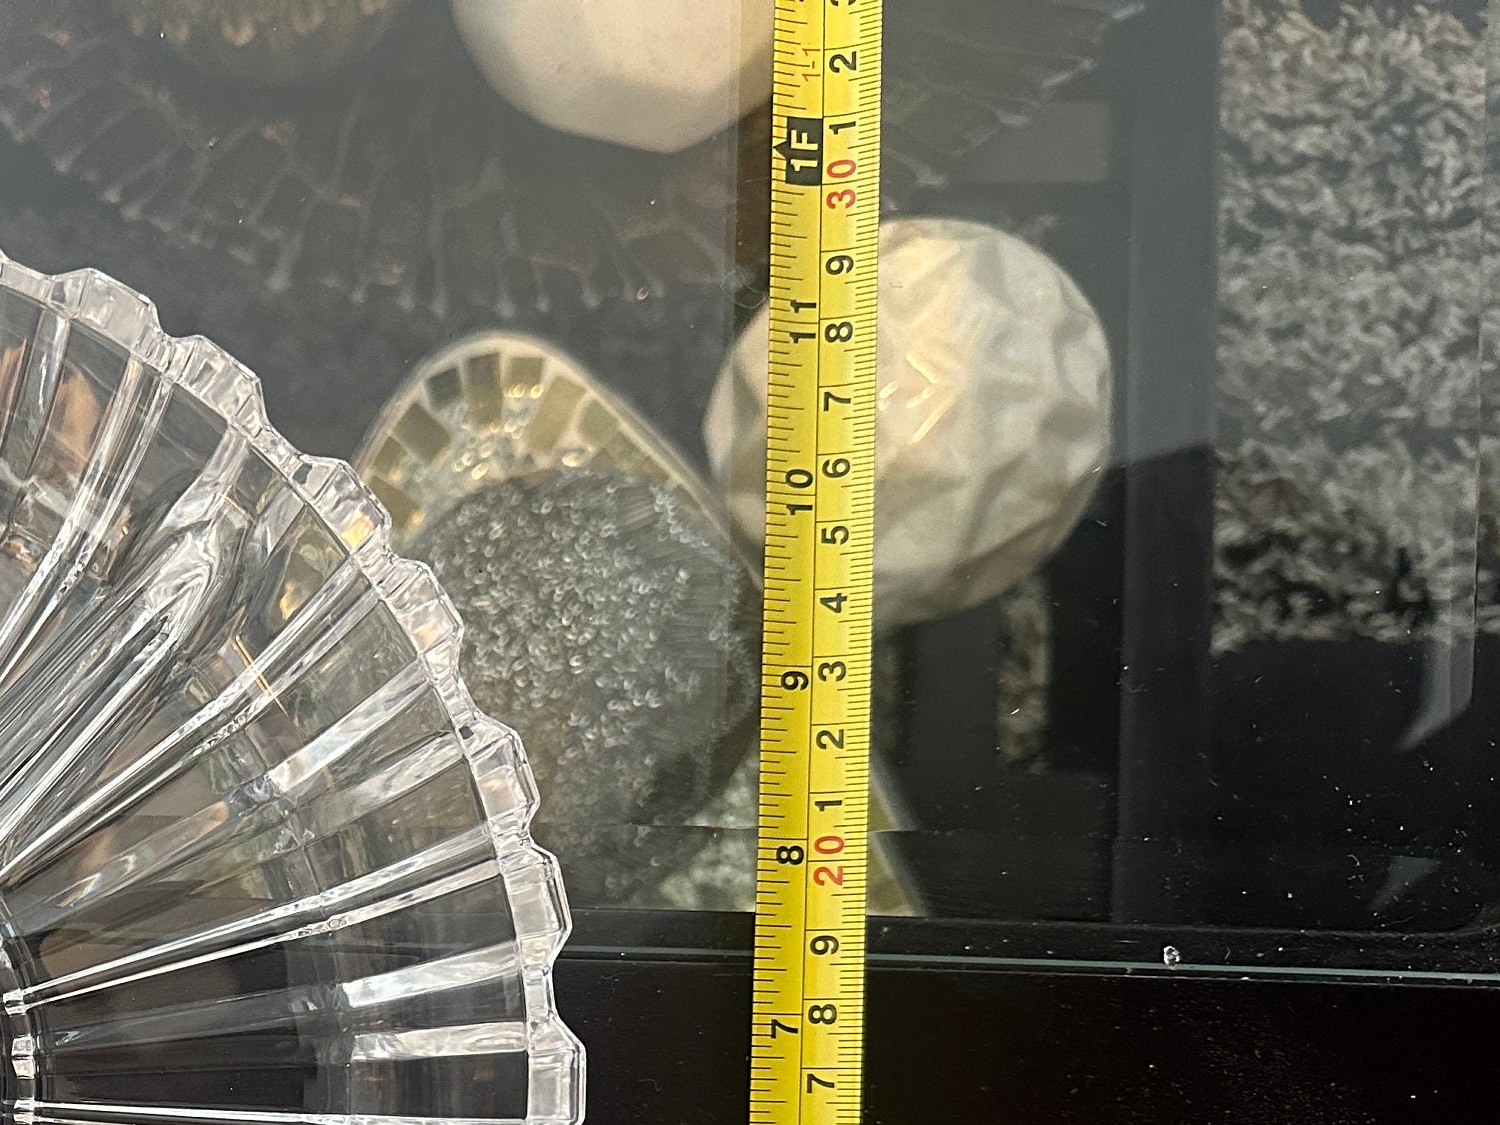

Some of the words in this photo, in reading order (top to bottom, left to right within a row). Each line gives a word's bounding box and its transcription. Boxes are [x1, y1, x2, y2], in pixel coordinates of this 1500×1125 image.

[829, 51, 857, 73] 2
[829, 121, 857, 135] 1
[790, 129, 819, 172] 1F
[825, 254, 854, 275] 9
[824, 321, 854, 343] 8
[823, 391, 852, 412] 7
[821, 458, 851, 479] 6
[821, 525, 849, 545] 5
[820, 593, 848, 614] 4
[780, 670, 809, 691] 9
[818, 660, 847, 682] 3
[816, 728, 845, 750] 2
[814, 799, 843, 812] 1
[776, 845, 805, 865] 8
[810, 935, 839, 956] 9
[808, 1003, 838, 1025] 8
[771, 1019, 798, 1039] 7
[806, 1073, 835, 1094] 7
